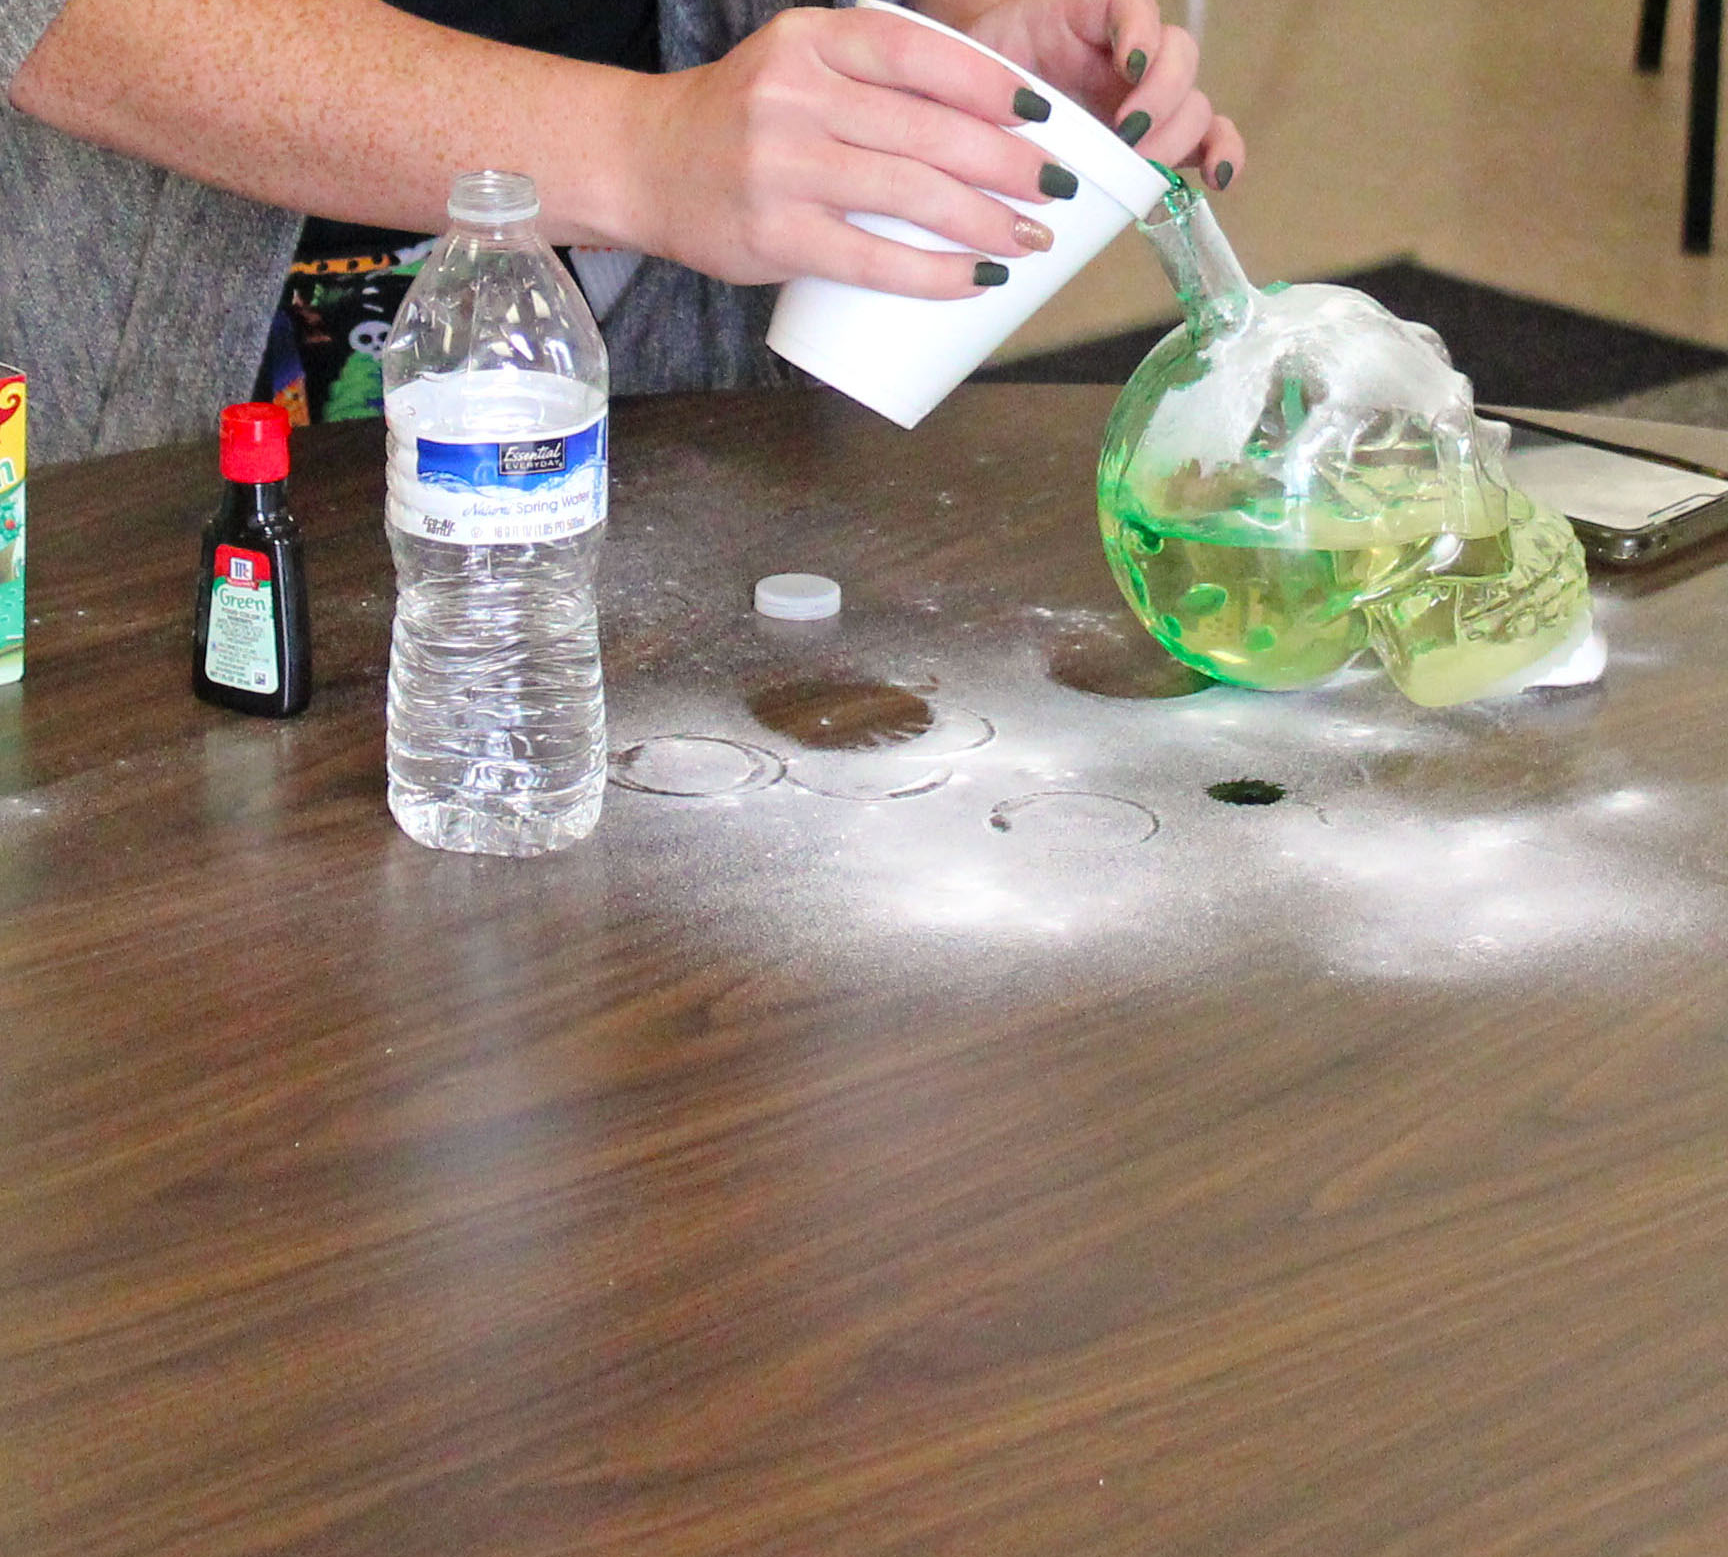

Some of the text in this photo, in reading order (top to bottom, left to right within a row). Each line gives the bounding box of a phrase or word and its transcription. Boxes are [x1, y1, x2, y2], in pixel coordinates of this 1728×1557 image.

[503, 442, 562, 462] Essential
[516, 498, 559, 520] Spring
[561, 491, 590, 508] Water
[219, 589, 266, 612] Green
